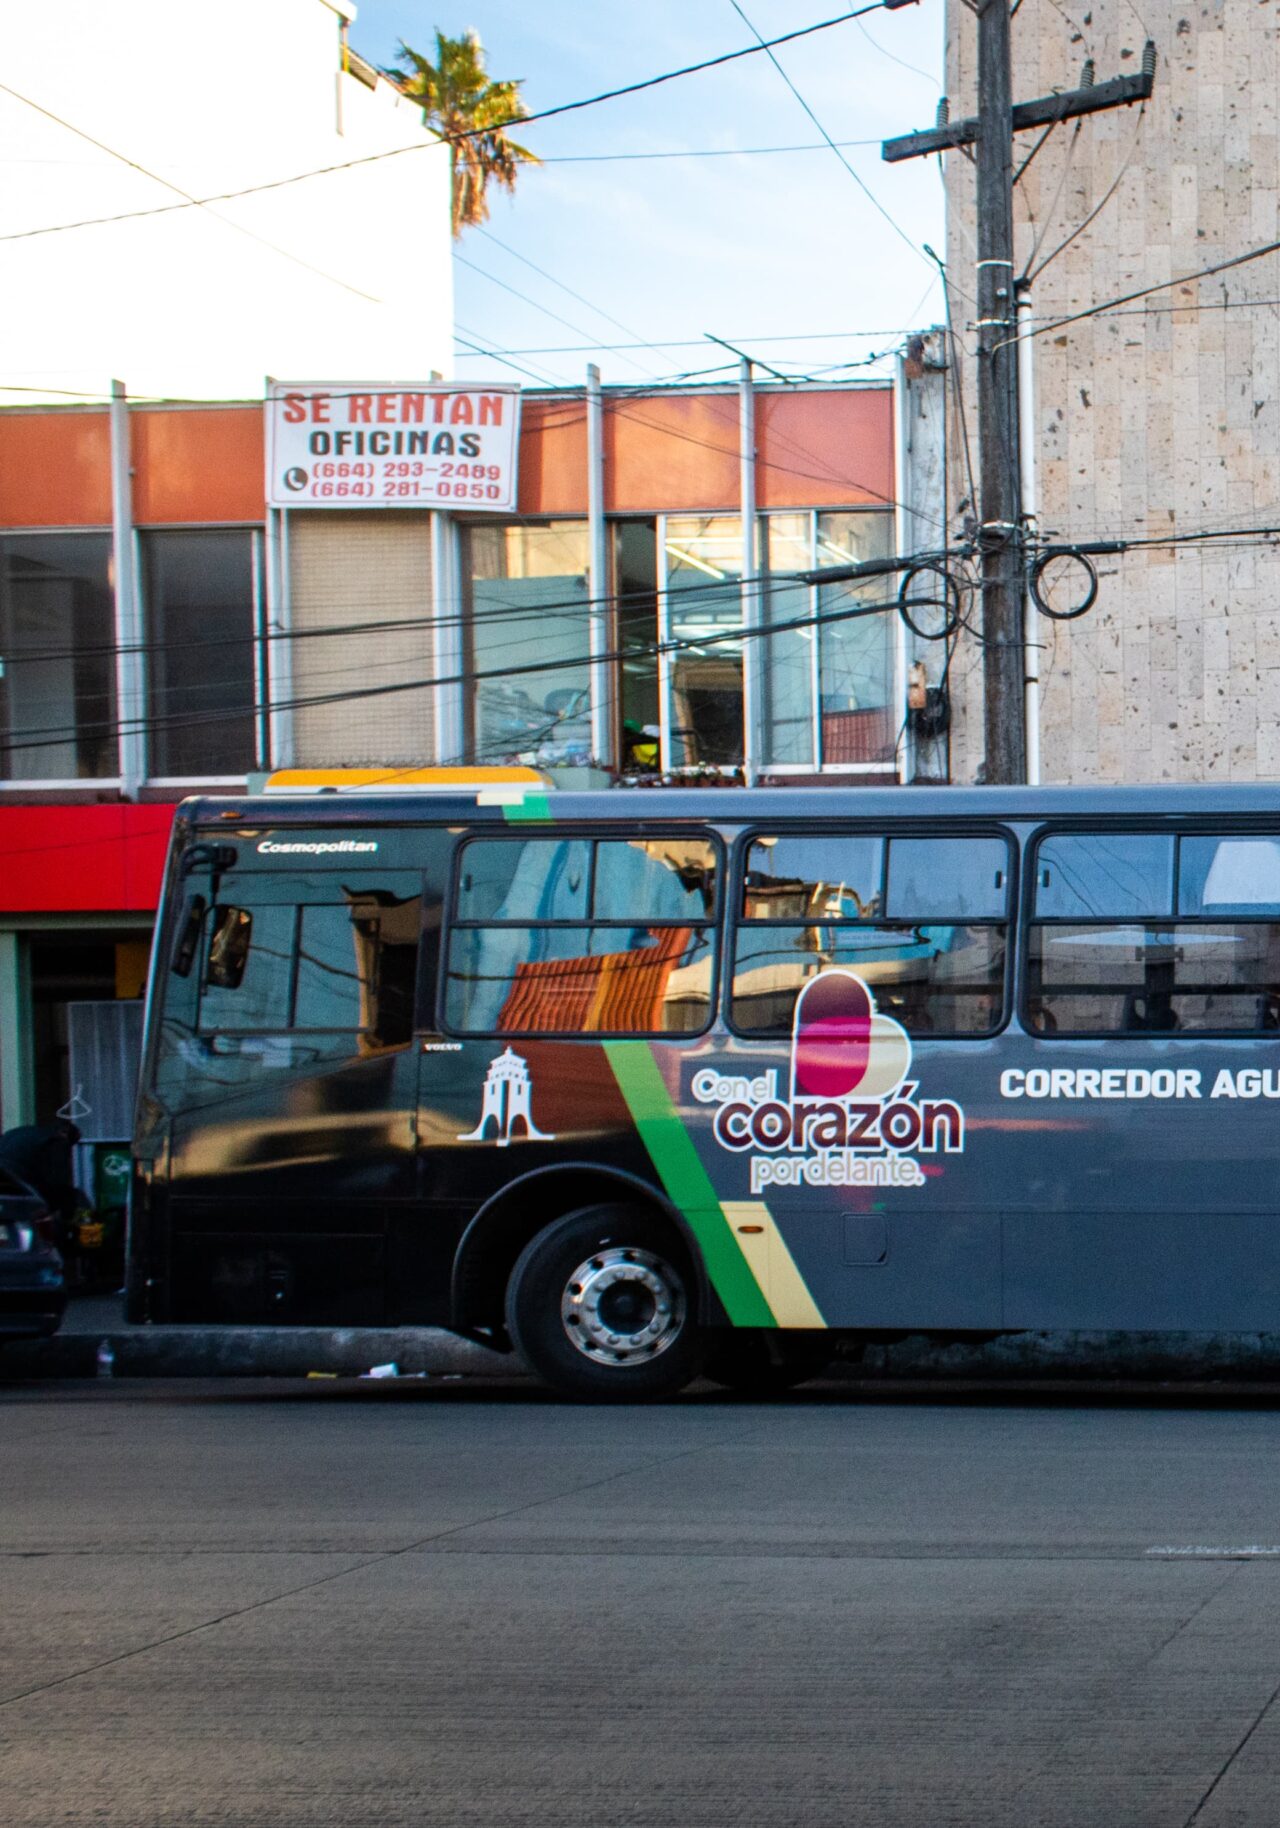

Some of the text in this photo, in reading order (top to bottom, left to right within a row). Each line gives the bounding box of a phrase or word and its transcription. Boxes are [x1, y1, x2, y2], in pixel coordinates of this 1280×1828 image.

[283, 393, 504, 426] SE RENTAN
[309, 431, 482, 458] OFICINAS
[313, 462, 501, 481] (664) 293-2489
[312, 481, 501, 500] (664) 281-0850
[257, 840, 378, 854] Cosmopolitan
[424, 1043, 463, 1051] VOLVO
[692, 1069, 777, 1102] Con el
[1000, 1069, 1202, 1098] CORREDOR
[714, 1080, 964, 1152] corazón
